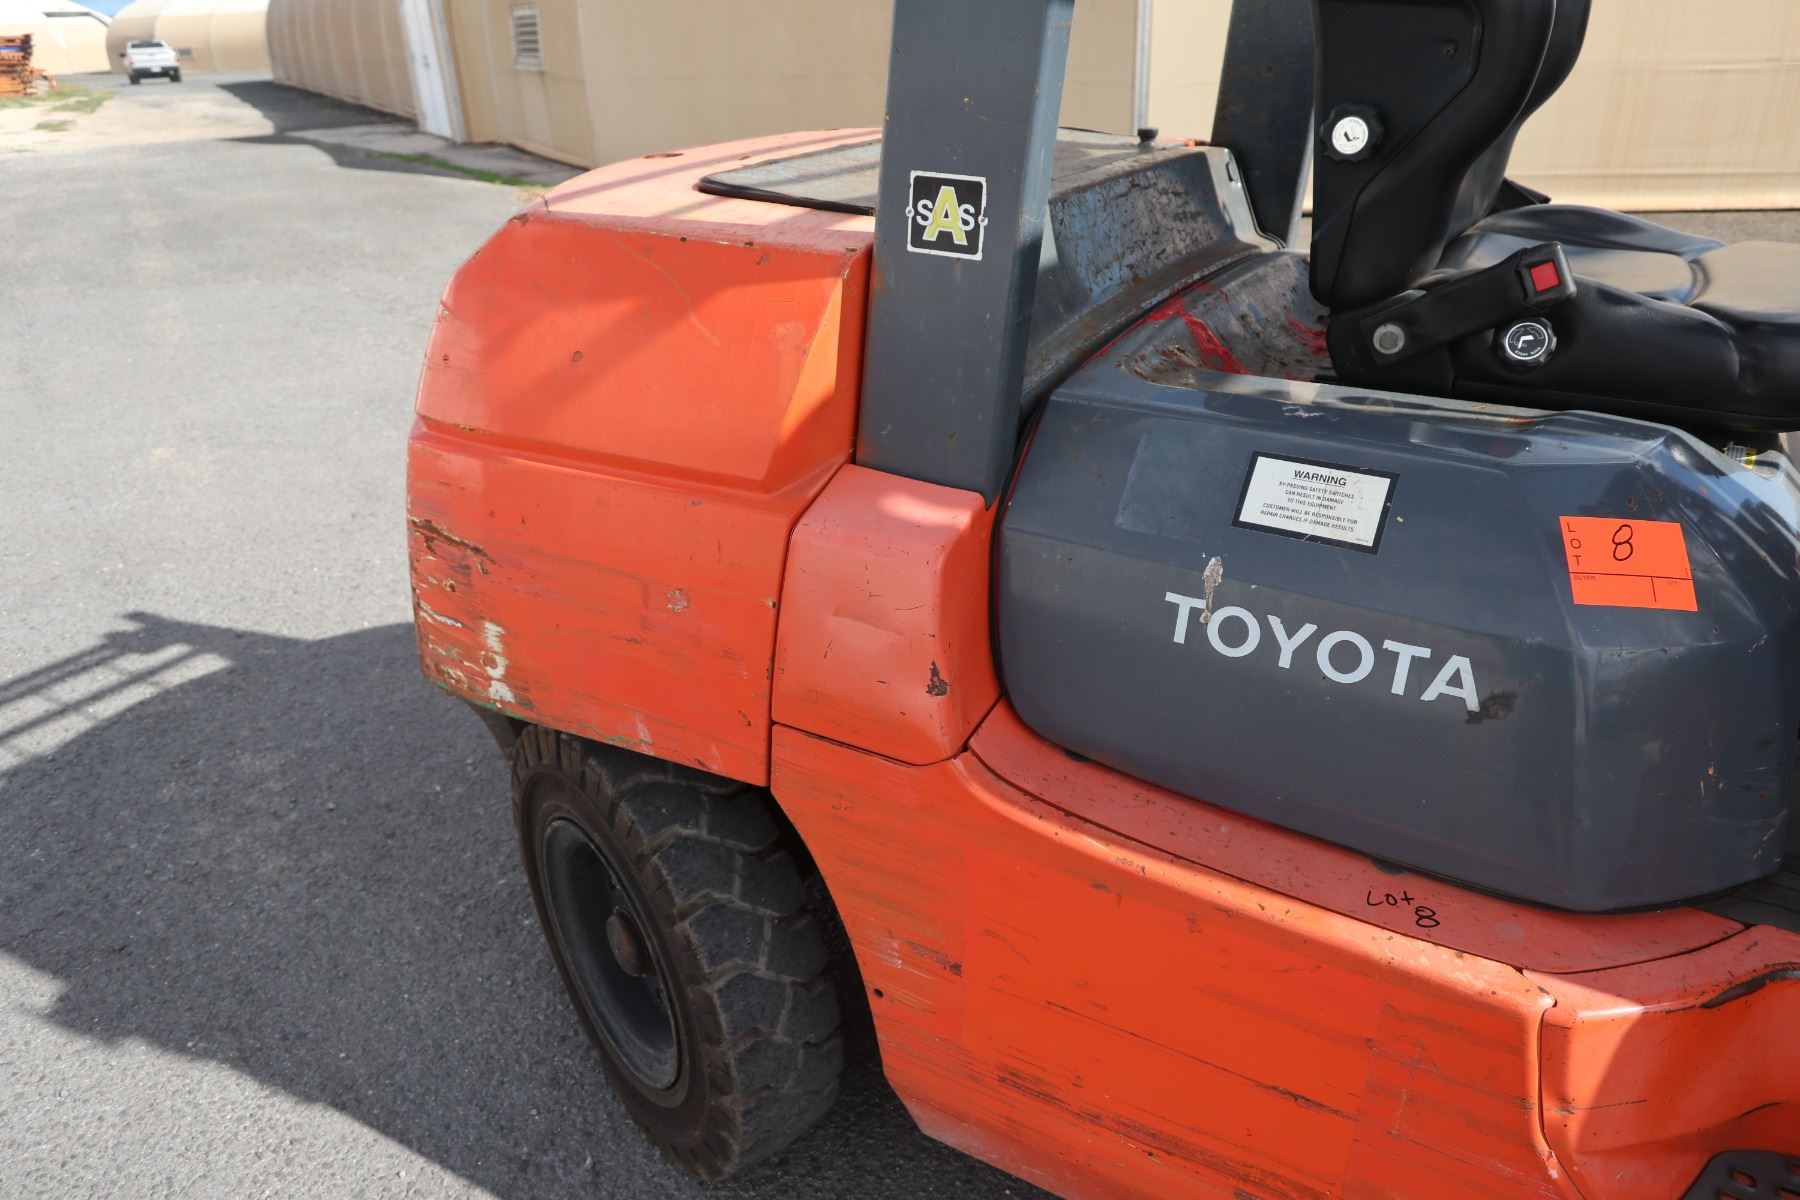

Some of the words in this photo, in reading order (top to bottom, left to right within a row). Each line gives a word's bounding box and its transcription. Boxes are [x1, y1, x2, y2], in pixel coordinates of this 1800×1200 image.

[916, 186, 976, 245] SAS
[1294, 470, 1347, 486] WARNING
[1298, 491, 1316, 499] RESULT
[1322, 495, 1344, 505] DAMAGE
[1309, 486, 1328, 494] SAFETY
[1263, 503, 1290, 512] CUSTOMER
[1296, 498, 1306, 506] THIS
[1566, 522, 1582, 566] LOT
[1611, 523, 1634, 562] 8
[1165, 591, 1480, 712] TOYOTA
[1415, 906, 1440, 928] 8
